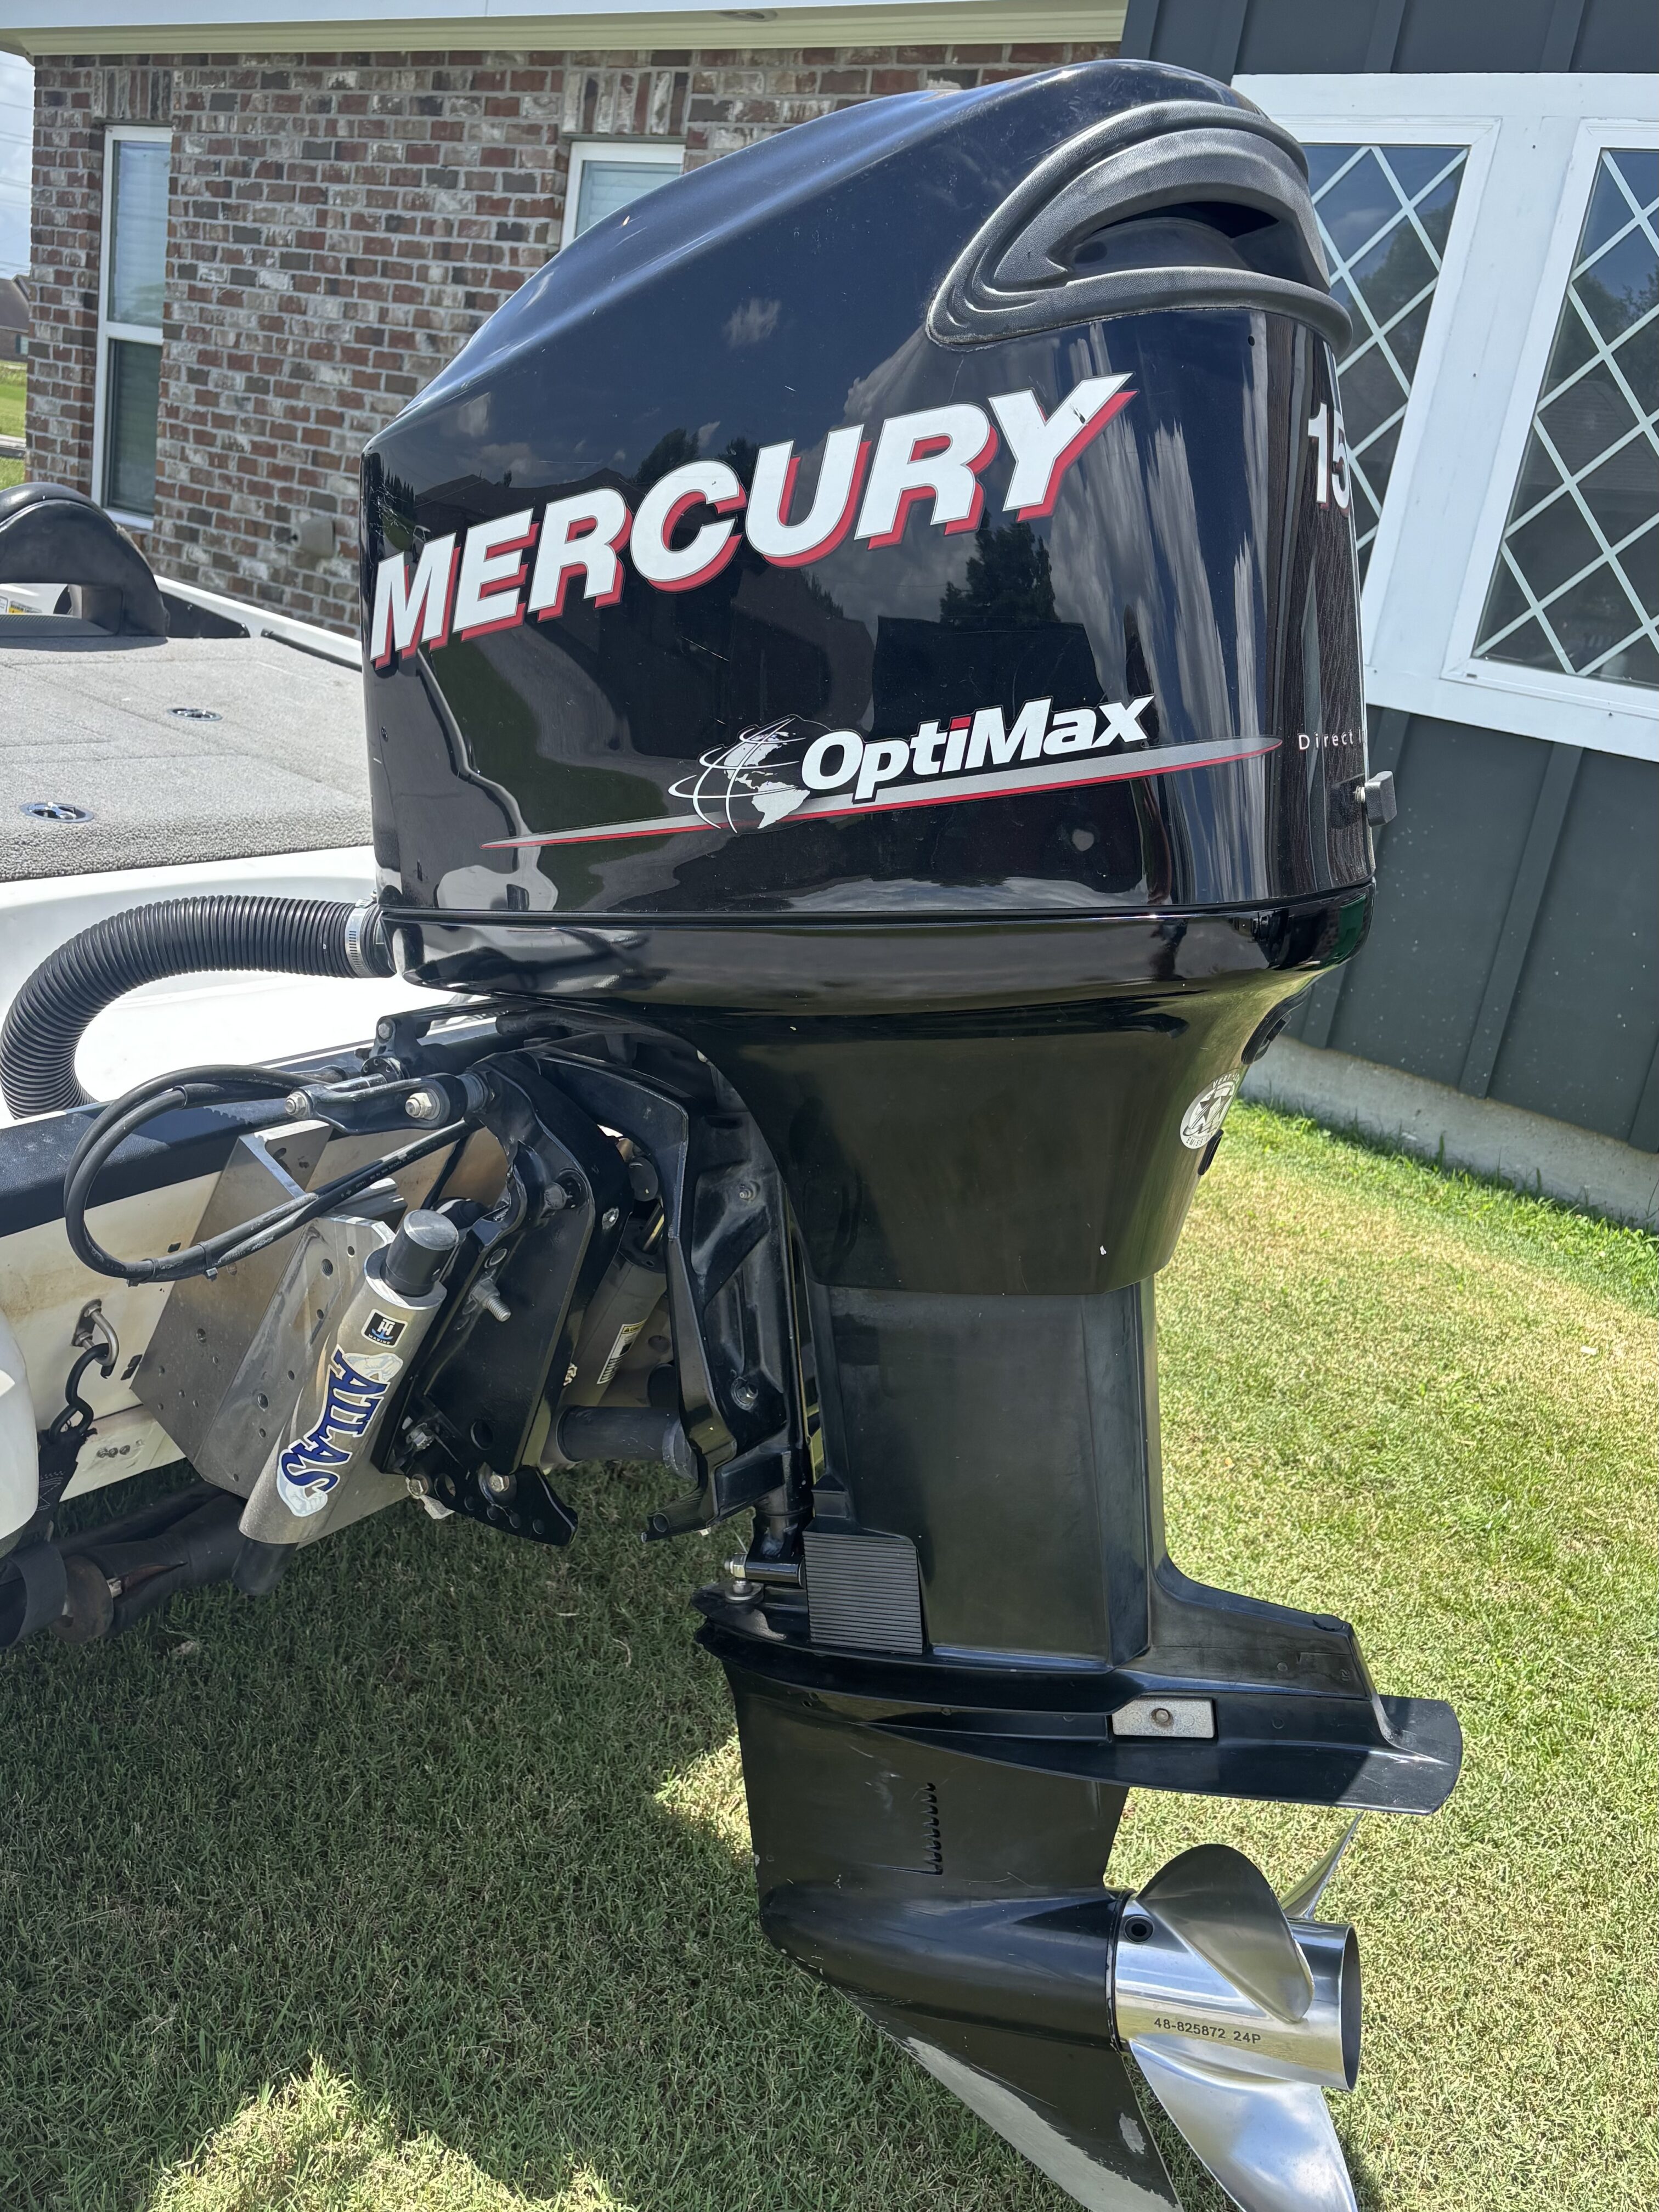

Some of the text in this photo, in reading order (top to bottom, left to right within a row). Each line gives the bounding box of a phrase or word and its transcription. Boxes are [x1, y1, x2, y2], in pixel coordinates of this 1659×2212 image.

[370, 373, 1137, 668] MERCURY
[802, 696, 1154, 800] OptiMax
[1298, 731, 1354, 750] Direct
[280, 1346, 390, 1493] ATLAS
[1153, 2017, 1262, 2044] 48-825872 24P
